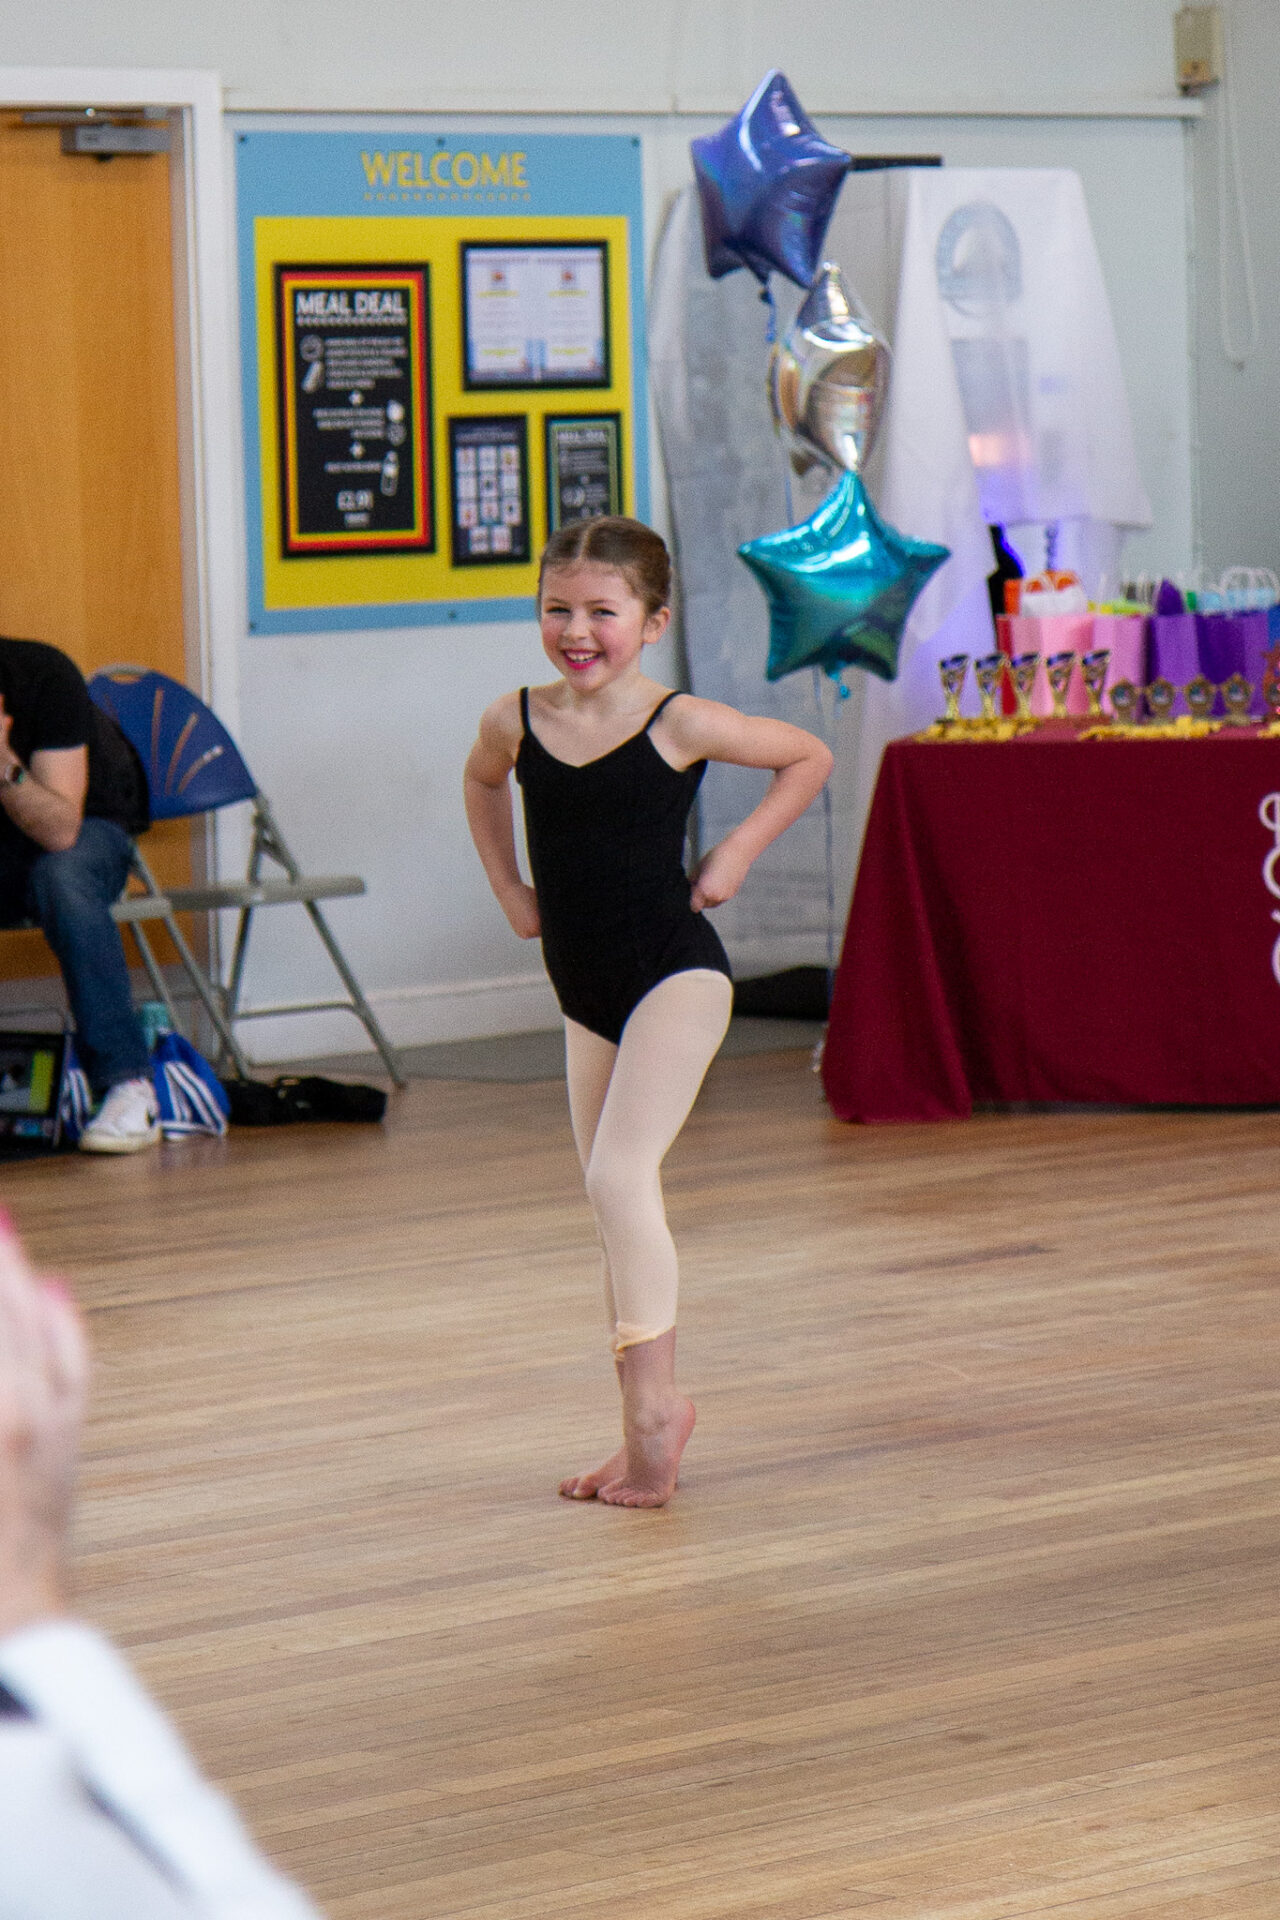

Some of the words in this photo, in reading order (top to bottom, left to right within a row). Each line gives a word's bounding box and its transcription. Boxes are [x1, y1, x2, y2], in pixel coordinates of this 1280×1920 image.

[361, 151, 529, 187] WELCOME
[296, 291, 352, 315] MEAL
[354, 291, 407, 315] DEAL
